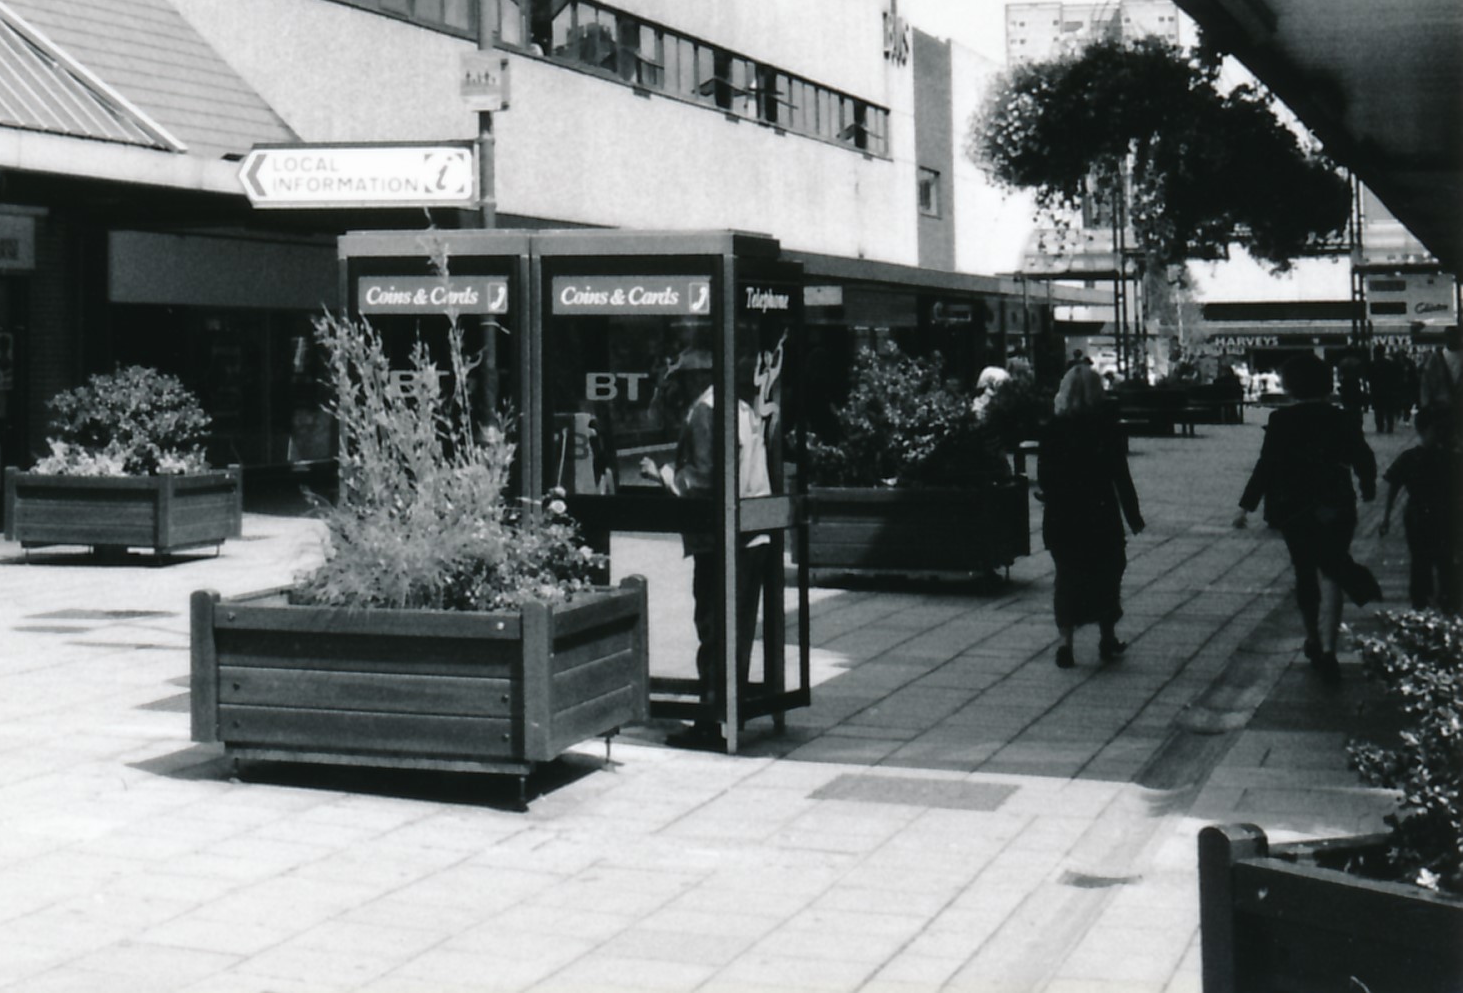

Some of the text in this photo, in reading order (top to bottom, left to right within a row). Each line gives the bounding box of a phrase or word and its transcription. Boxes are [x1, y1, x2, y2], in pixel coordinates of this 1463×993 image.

[272, 156, 340, 173] LOCAL
[272, 176, 419, 194] INFORMATION
[365, 285, 479, 306] Coins & Cards
[560, 285, 680, 306] Coins & Cards
[744, 286, 790, 314] Telephone
[1214, 335, 1279, 347] HARVEYS
[585, 371, 649, 402] BT
